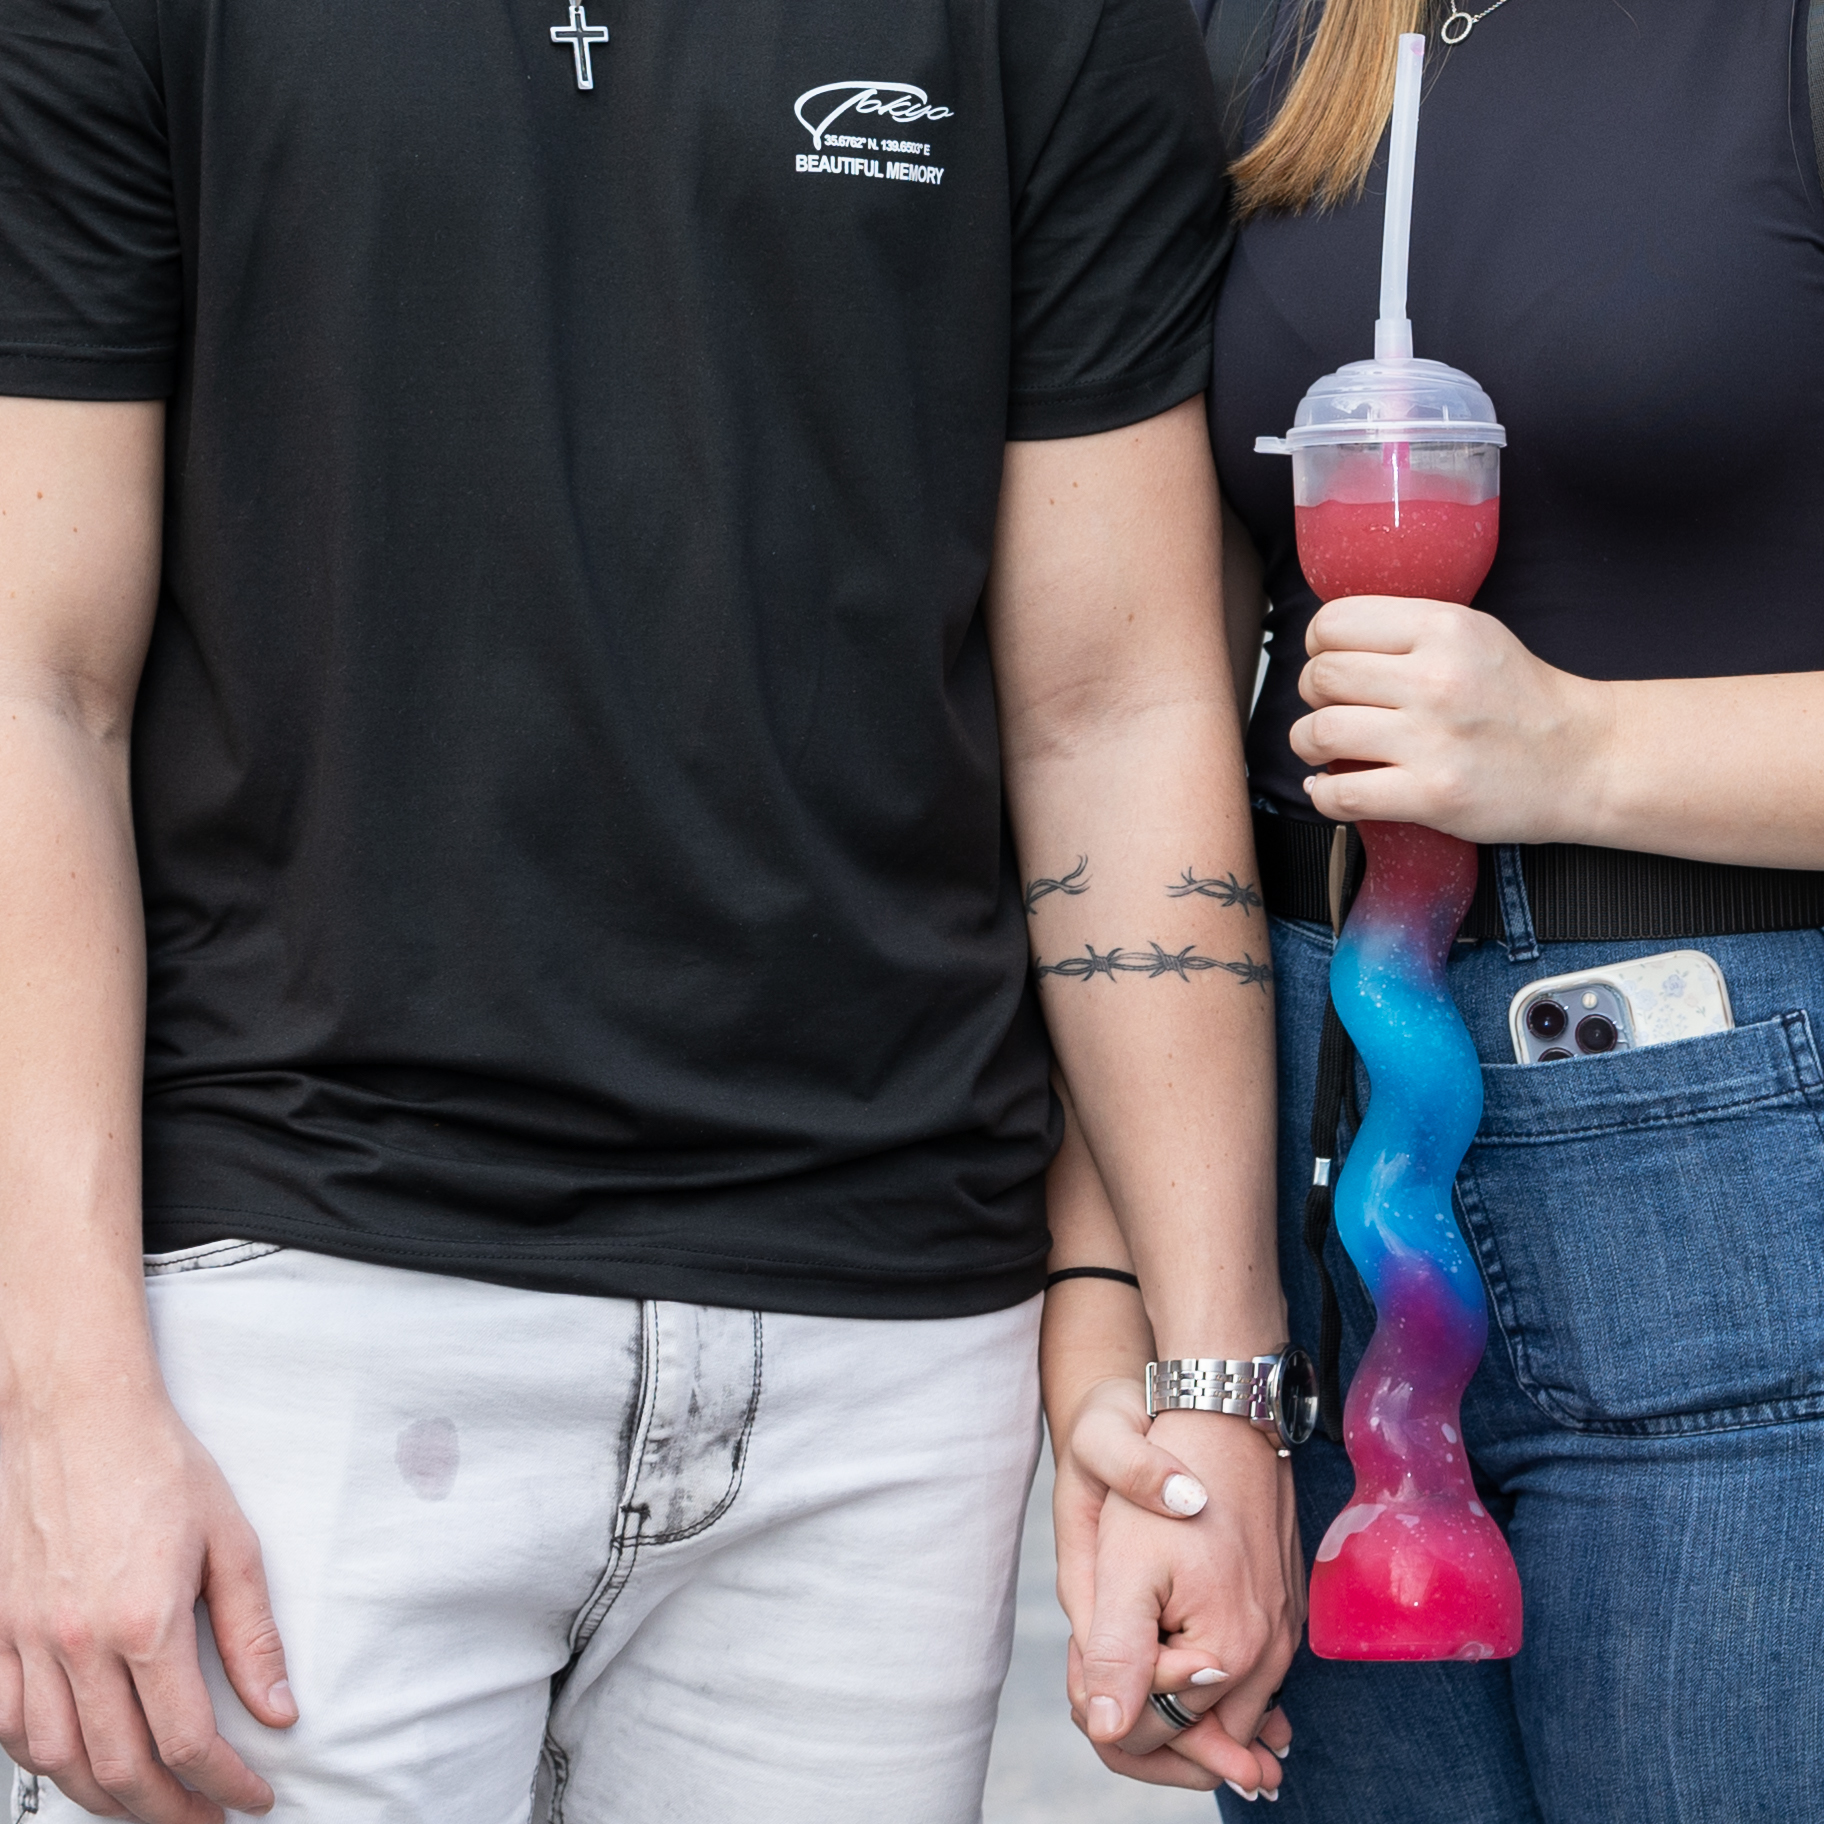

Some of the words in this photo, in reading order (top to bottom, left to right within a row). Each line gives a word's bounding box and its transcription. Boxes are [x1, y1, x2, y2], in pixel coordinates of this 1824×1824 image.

[794, 80, 955, 151] Tokyo
[795, 154, 885, 179] BEAUTIFUL
[886, 160, 945, 186] MEMORY
